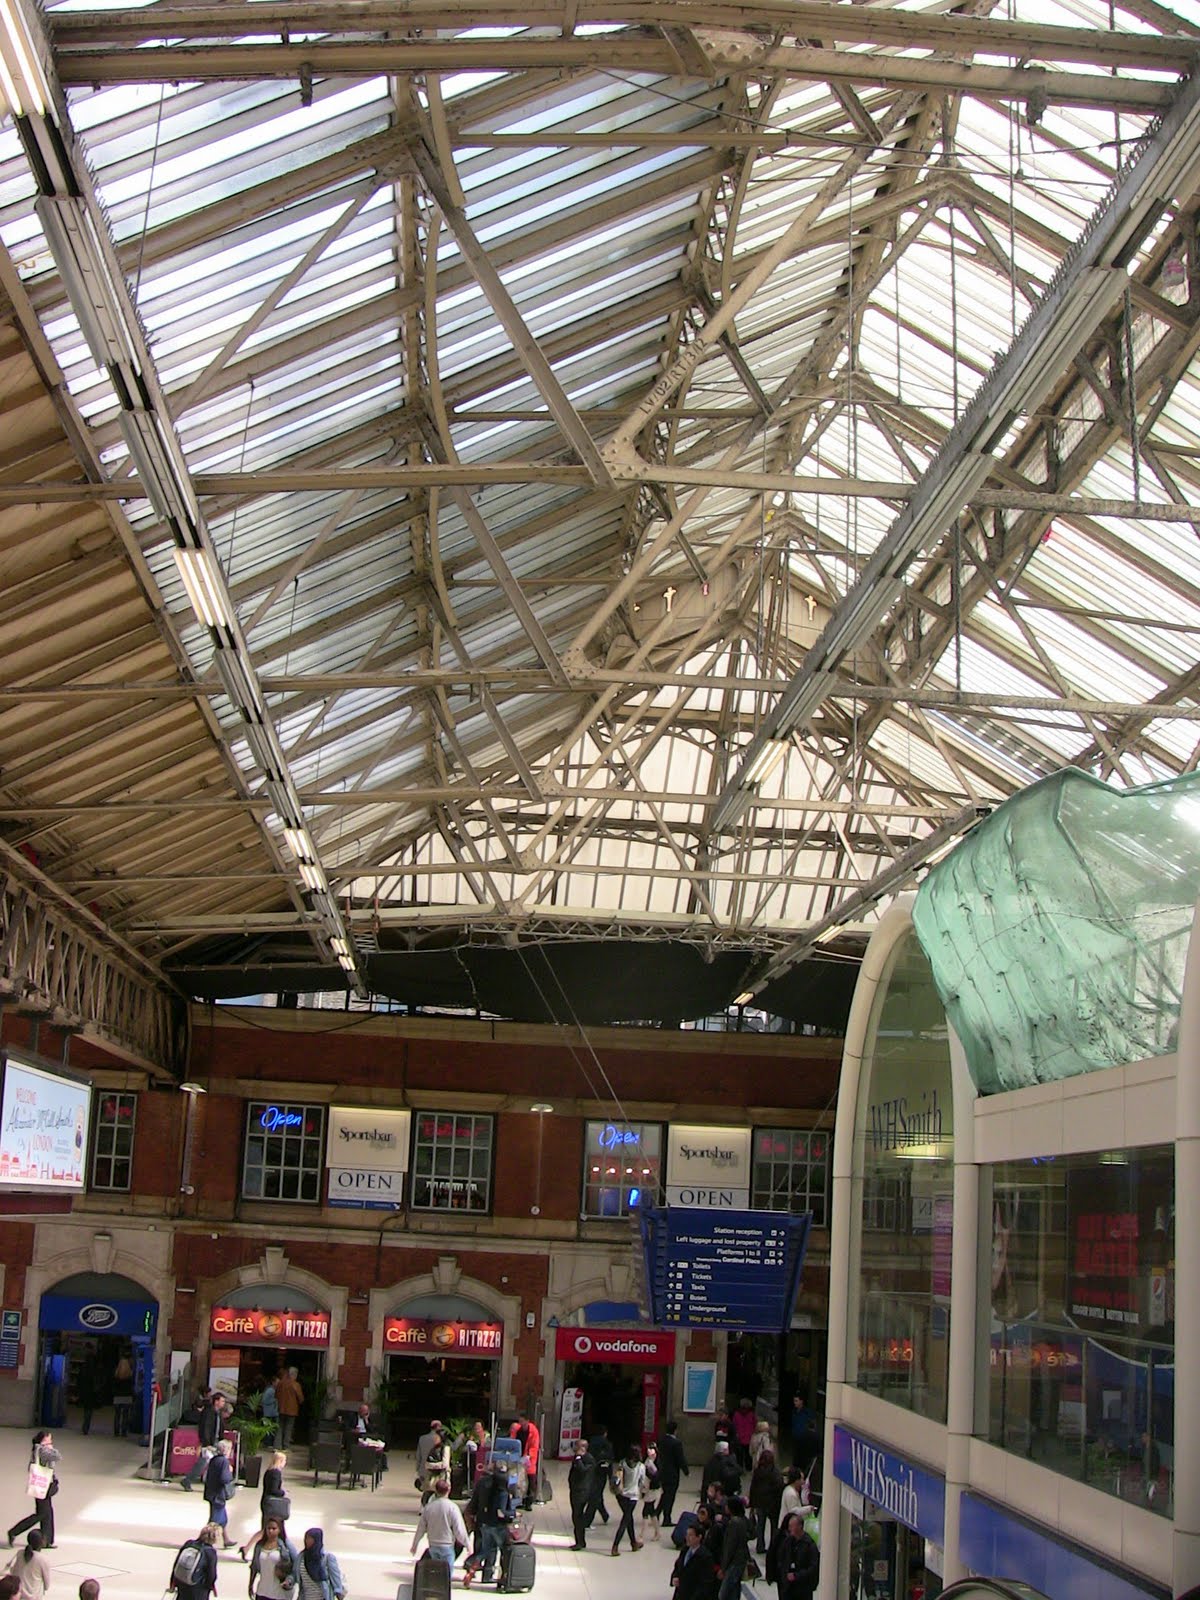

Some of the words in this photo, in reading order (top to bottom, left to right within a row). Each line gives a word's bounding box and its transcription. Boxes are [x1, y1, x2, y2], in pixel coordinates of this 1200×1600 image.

[260, 1107, 303, 1132] Open
[871, 1088, 942, 1152] WHSmith
[338, 1126, 393, 1143] Sportsbar
[598, 1124, 640, 1150] Open
[680, 1144, 734, 1160] Sportsbar
[338, 1171, 392, 1189] OPEN
[679, 1189, 733, 1206] OPEN
[689, 1237, 712, 1245] luggage
[716, 1248, 744, 1256] Platforms
[692, 1262, 711, 1270] Toilets
[691, 1283, 706, 1291] Taxis
[85, 1309, 111, 1323] Boots
[688, 1305, 726, 1313] Underground
[213, 1317, 254, 1333] Caffè
[285, 1319, 328, 1339] RITAZZA
[386, 1327, 427, 1343] Caffè
[459, 1329, 501, 1348] RITAZZA
[595, 1340, 657, 1354] vodafone
[850, 1437, 919, 1528] WHSmith
